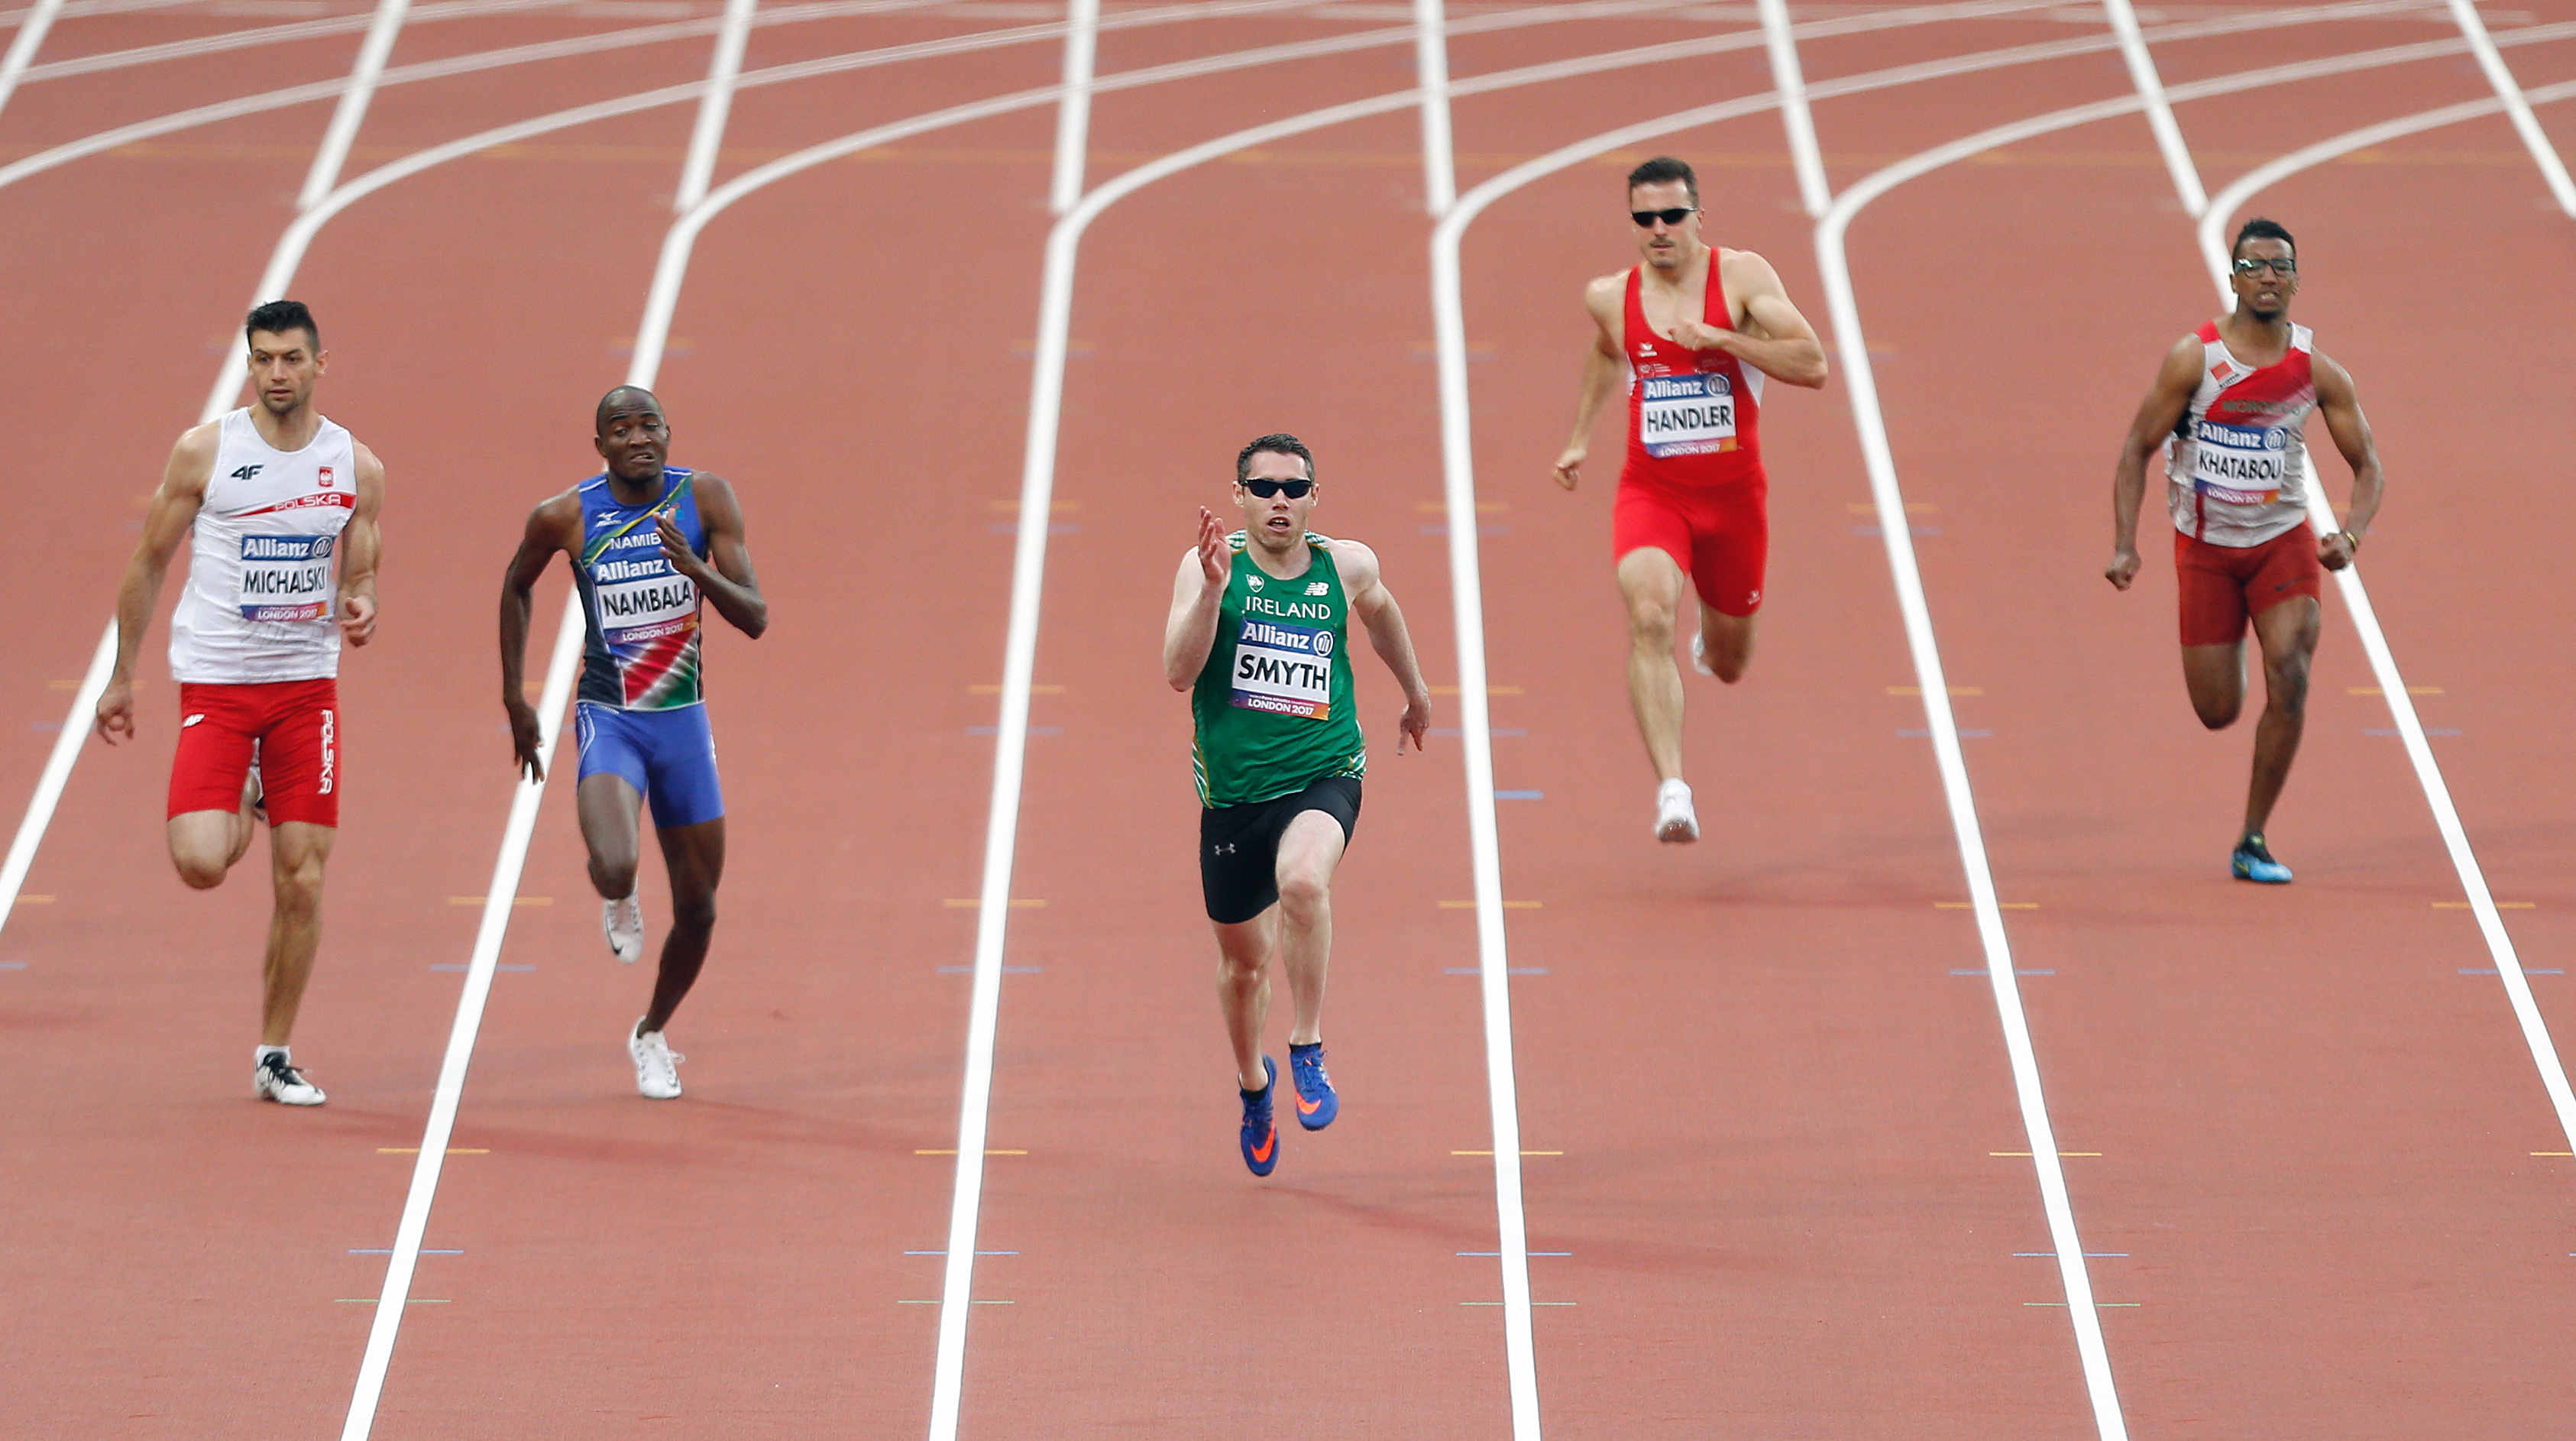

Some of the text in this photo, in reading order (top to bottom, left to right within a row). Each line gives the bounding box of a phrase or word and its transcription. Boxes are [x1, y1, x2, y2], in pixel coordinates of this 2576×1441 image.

[1646, 379, 1704, 399] Allianz
[1647, 405, 1733, 433] HANDLER
[2200, 422, 2262, 448] Allianz
[1661, 445, 1700, 456] LONDON
[231, 464, 265, 481] 4F
[2199, 449, 2281, 481] KHATABOU
[274, 494, 341, 511] POLSKA
[243, 538, 311, 557] Allianz
[610, 533, 662, 550] NAMIB
[244, 566, 326, 594] MICHALSKI
[597, 558, 666, 583] Allianz
[603, 581, 694, 617] NAMBALA
[1246, 596, 1331, 620] IRELAND
[257, 610, 299, 620] LONDON
[623, 627, 665, 641] LONDON
[665, 623, 684, 635] 2017
[1241, 623, 1310, 649] Allianz
[1238, 653, 1327, 691] SMYTH
[1248, 698, 1291, 712] LONDON
[1291, 706, 1315, 716] 2017
[319, 709, 335, 795] POLSKA
